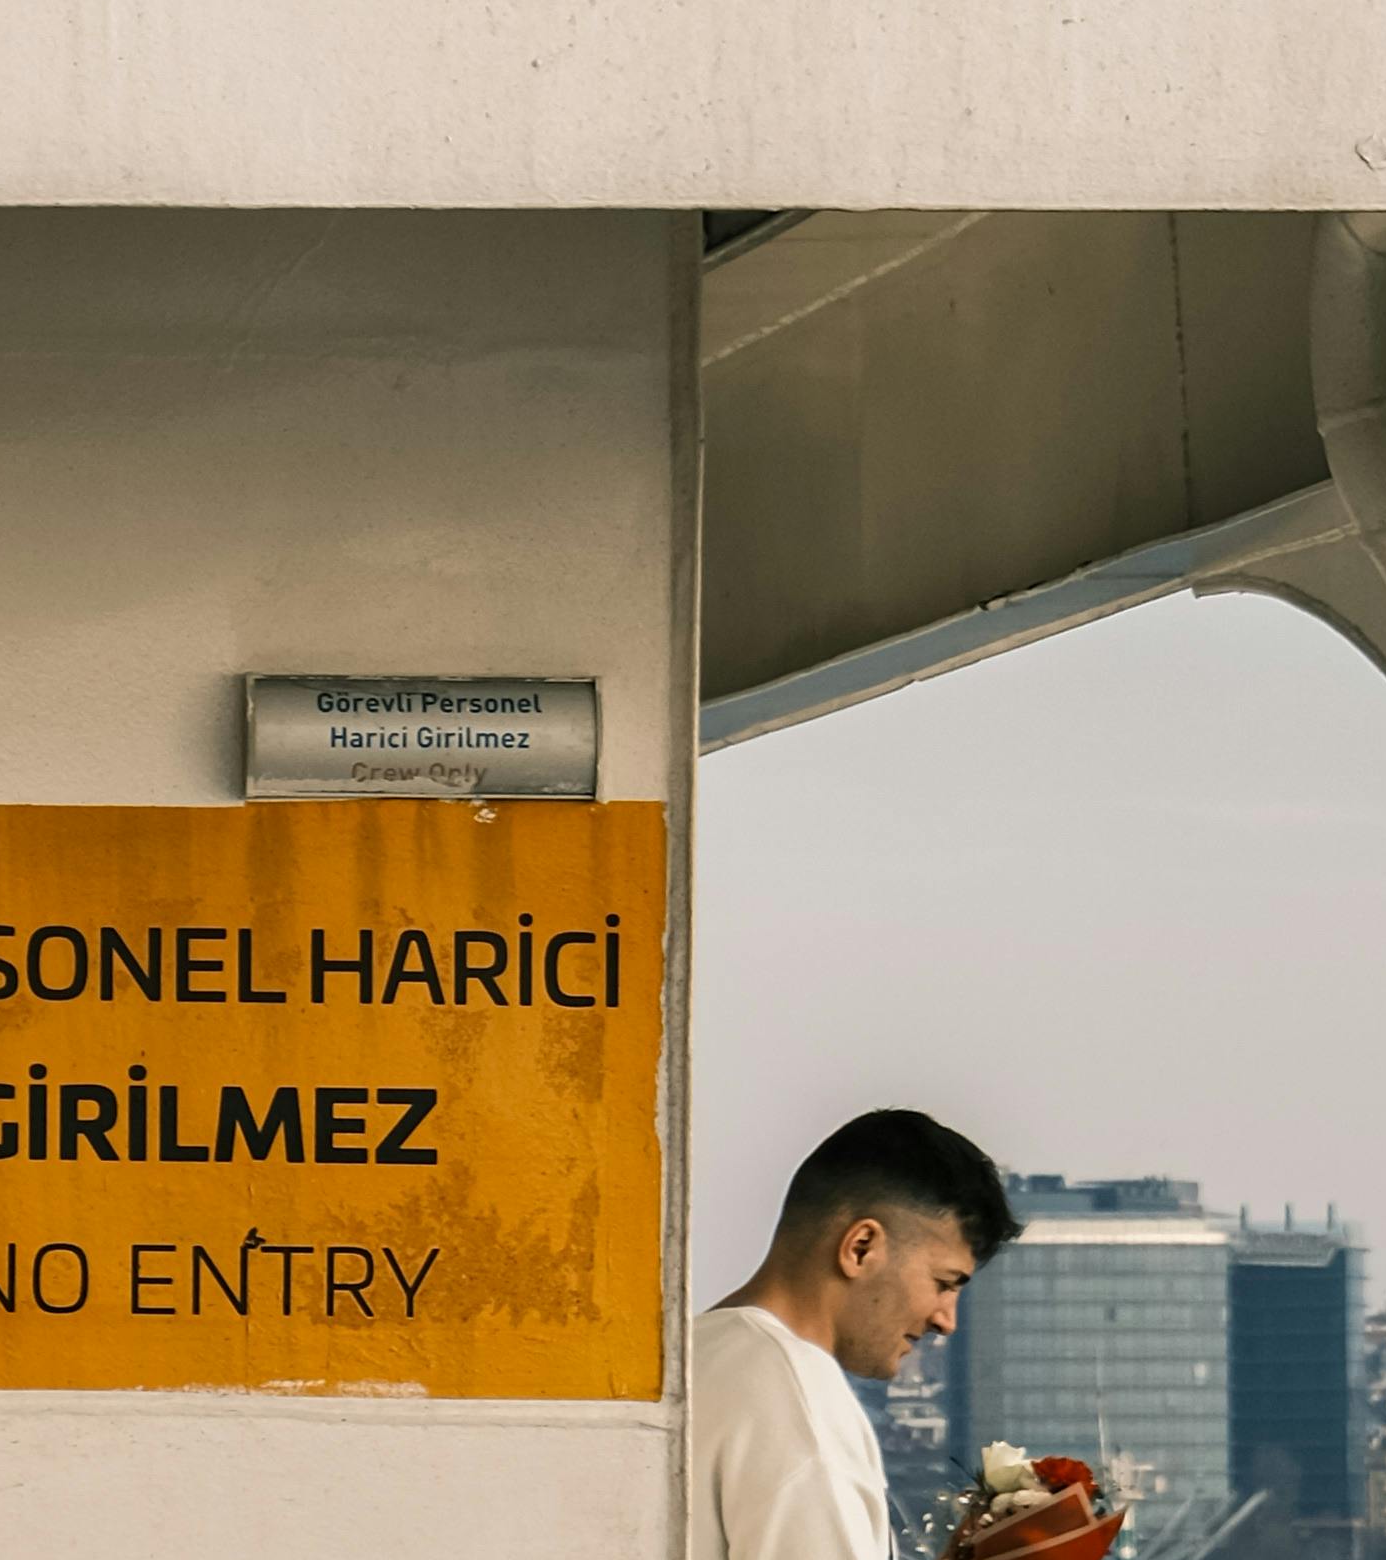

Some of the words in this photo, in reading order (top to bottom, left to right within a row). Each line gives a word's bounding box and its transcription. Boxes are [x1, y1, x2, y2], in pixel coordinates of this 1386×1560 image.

[317, 693, 411, 713] Görevli
[421, 693, 543, 713] Personel
[330, 727, 408, 748] Harici
[416, 727, 530, 749] Girilmez
[351, 762, 421, 783] Crew
[311, 912, 620, 1008] HARİCİ
[131, 1243, 440, 1318] ENTRY
